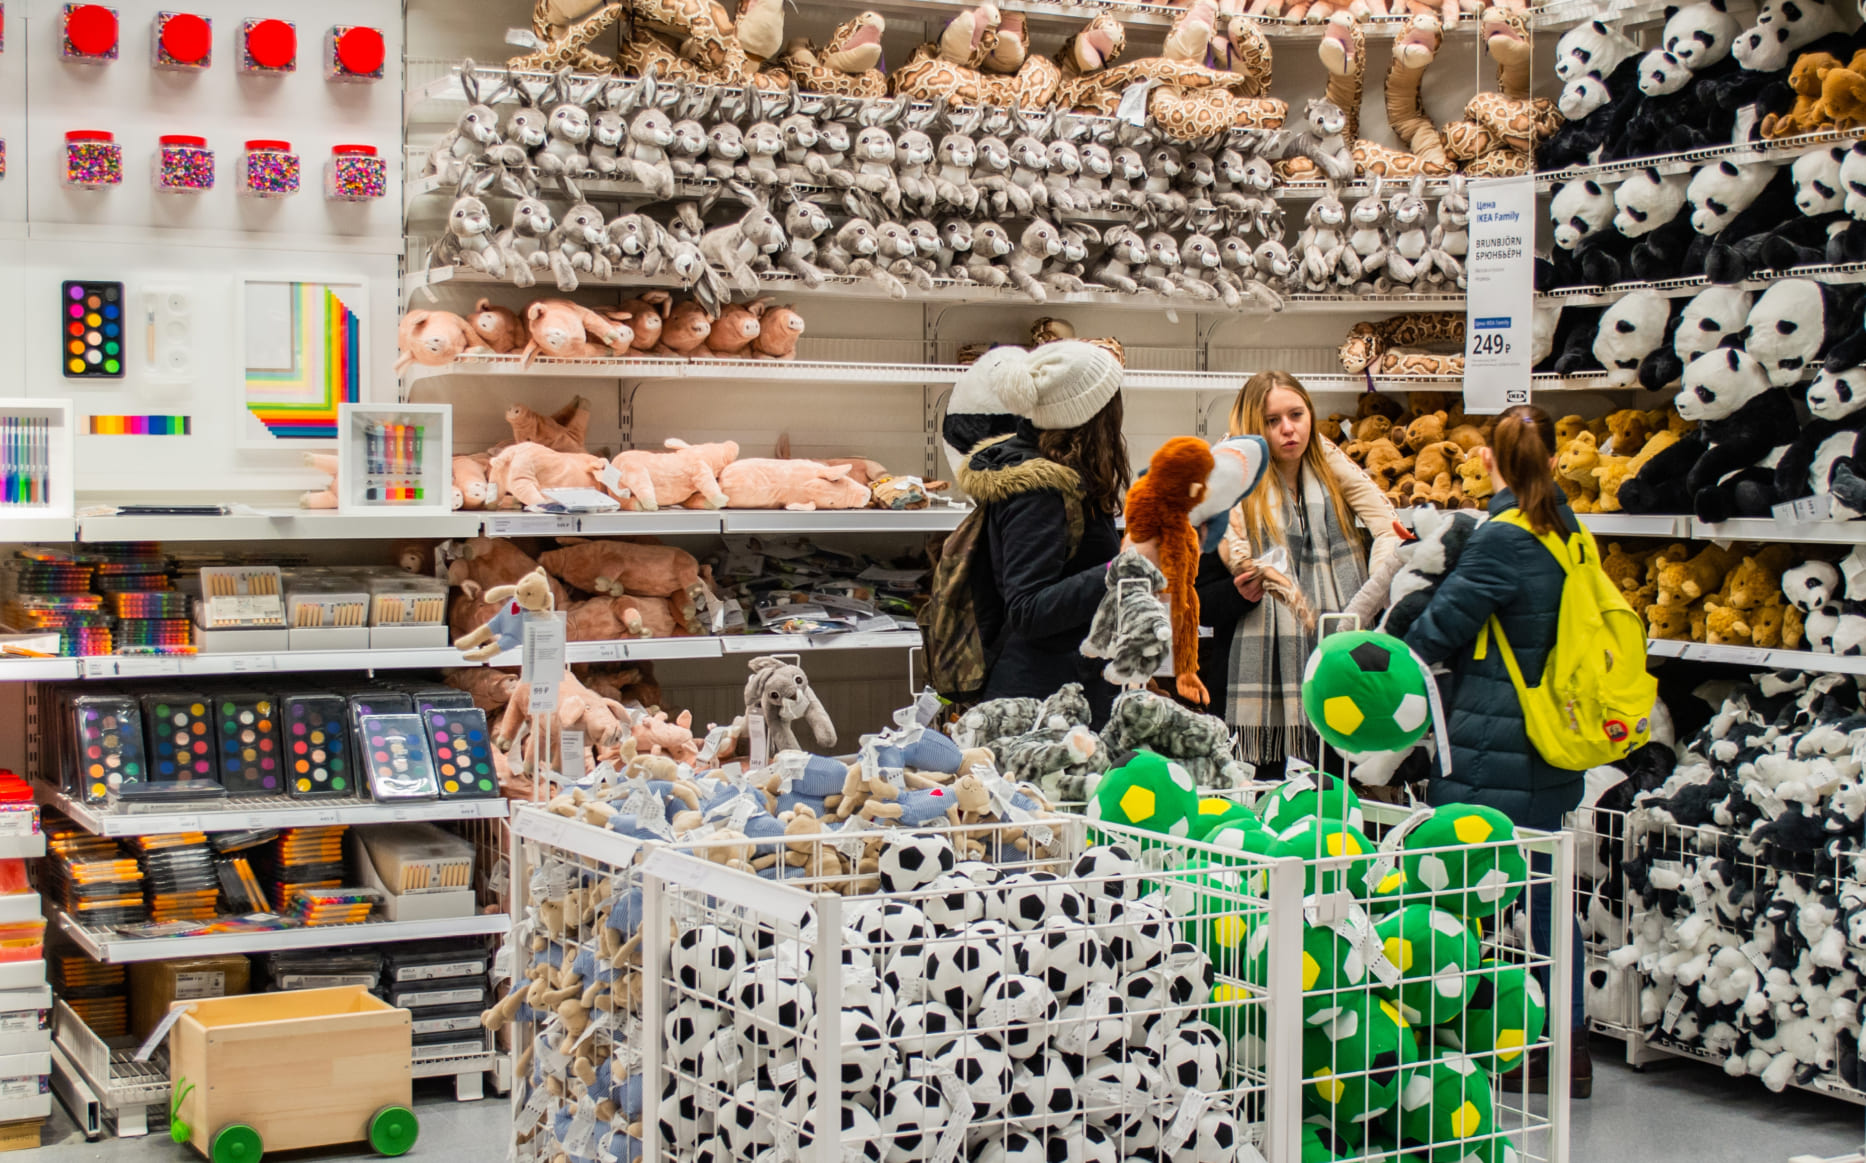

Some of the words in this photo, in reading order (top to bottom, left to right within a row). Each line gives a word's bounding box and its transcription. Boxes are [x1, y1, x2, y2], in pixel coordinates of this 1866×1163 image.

[1476, 201, 1496, 211] Цена
[1476, 213, 1493, 223] IKEA
[1494, 211, 1520, 223] Family
[1475, 235, 1522, 249] BRUNBJÖRN
[1475, 248, 1522, 261] БРЮНБЬЁРН
